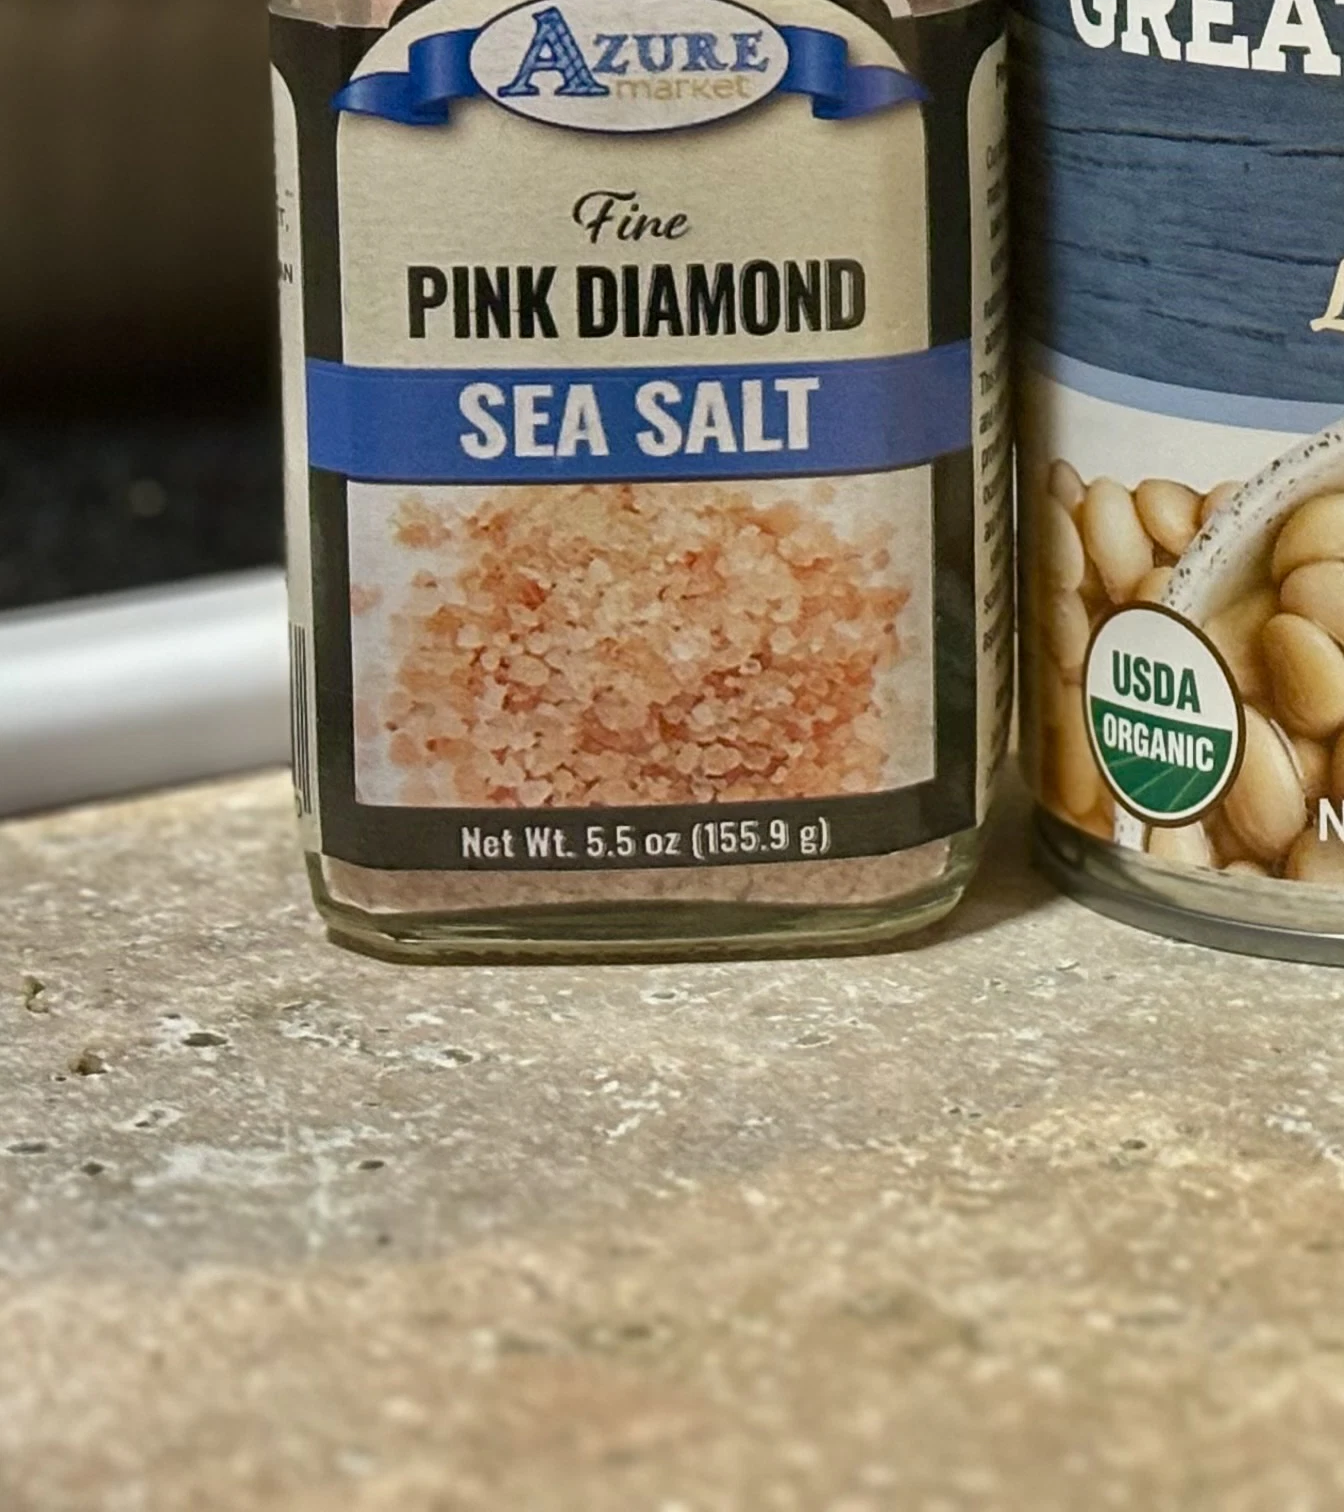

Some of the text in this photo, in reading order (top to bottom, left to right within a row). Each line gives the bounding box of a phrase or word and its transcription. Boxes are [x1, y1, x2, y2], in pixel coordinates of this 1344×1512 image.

[496, 5, 770, 98] AZURE
[612, 74, 752, 101] market
[572, 190, 690, 244] Fine
[407, 259, 867, 340] PINK DIAMOND
[458, 377, 821, 460] SEA SALT
[1112, 649, 1202, 714] USDA
[1102, 712, 1215, 773] ORGANIC
[460, 816, 831, 860] Net Wt. 5.5 oz (155.9 g)
